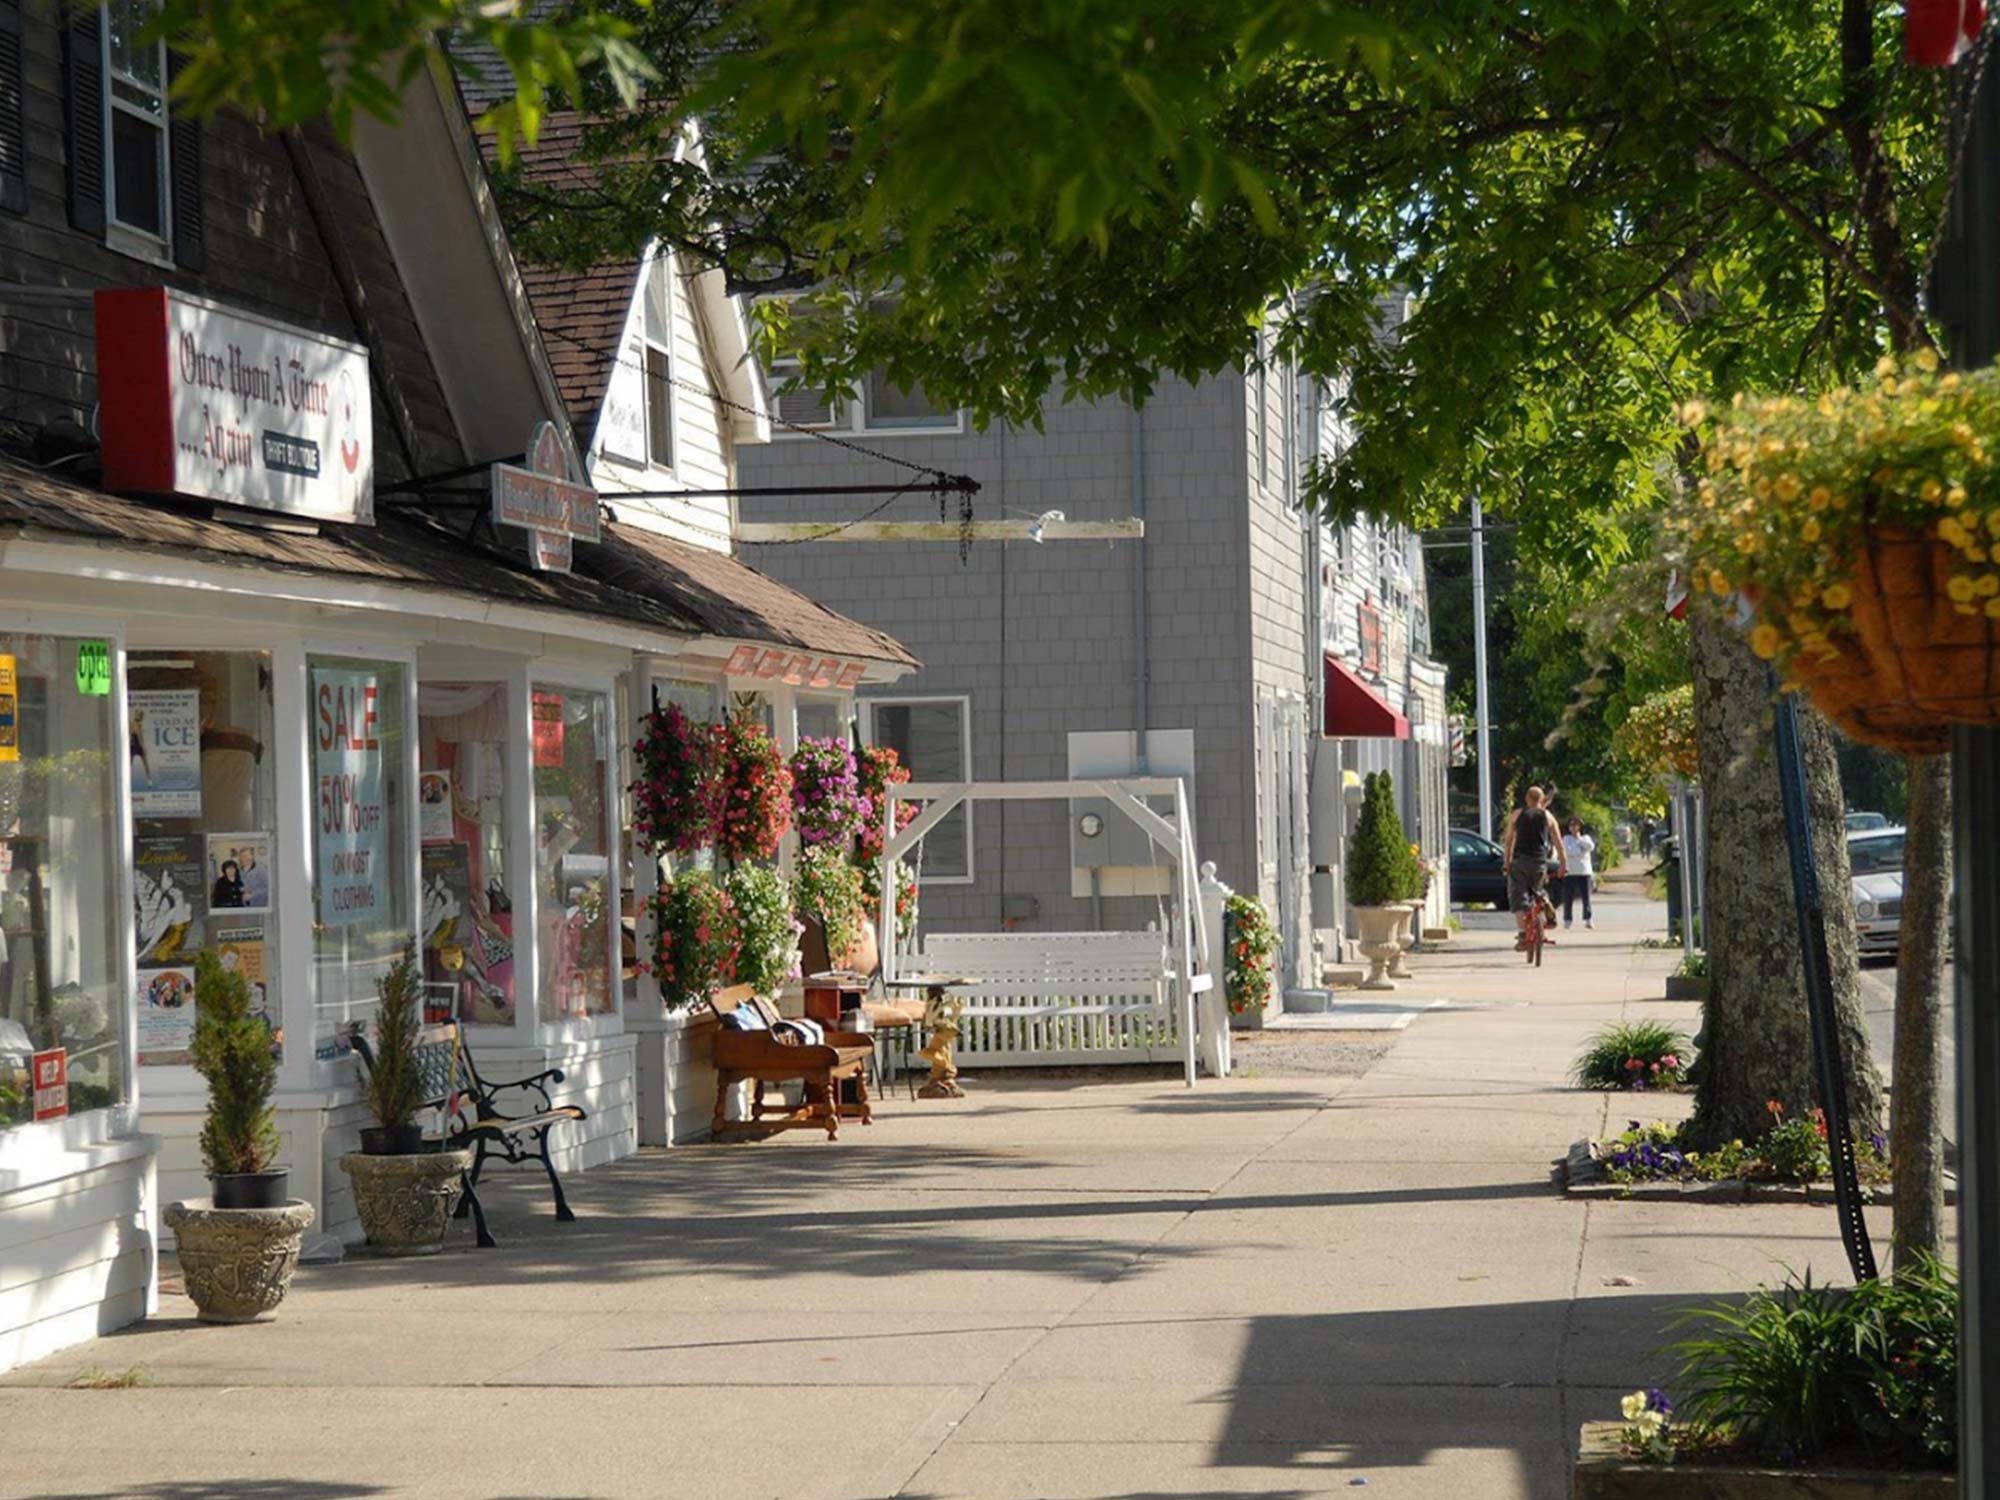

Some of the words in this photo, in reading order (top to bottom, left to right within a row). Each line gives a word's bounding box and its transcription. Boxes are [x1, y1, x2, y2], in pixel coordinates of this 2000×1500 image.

[180, 331, 224, 391] Once
[228, 344, 271, 413] Upon
[273, 356, 286, 407] A
[288, 354, 329, 417] Time
[154, 727, 197, 747] ICE
[319, 684, 379, 752] SALE
[321, 772, 362, 834] 50%
[361, 805, 381, 833] OFF
[332, 885, 376, 911] CLOTHING
